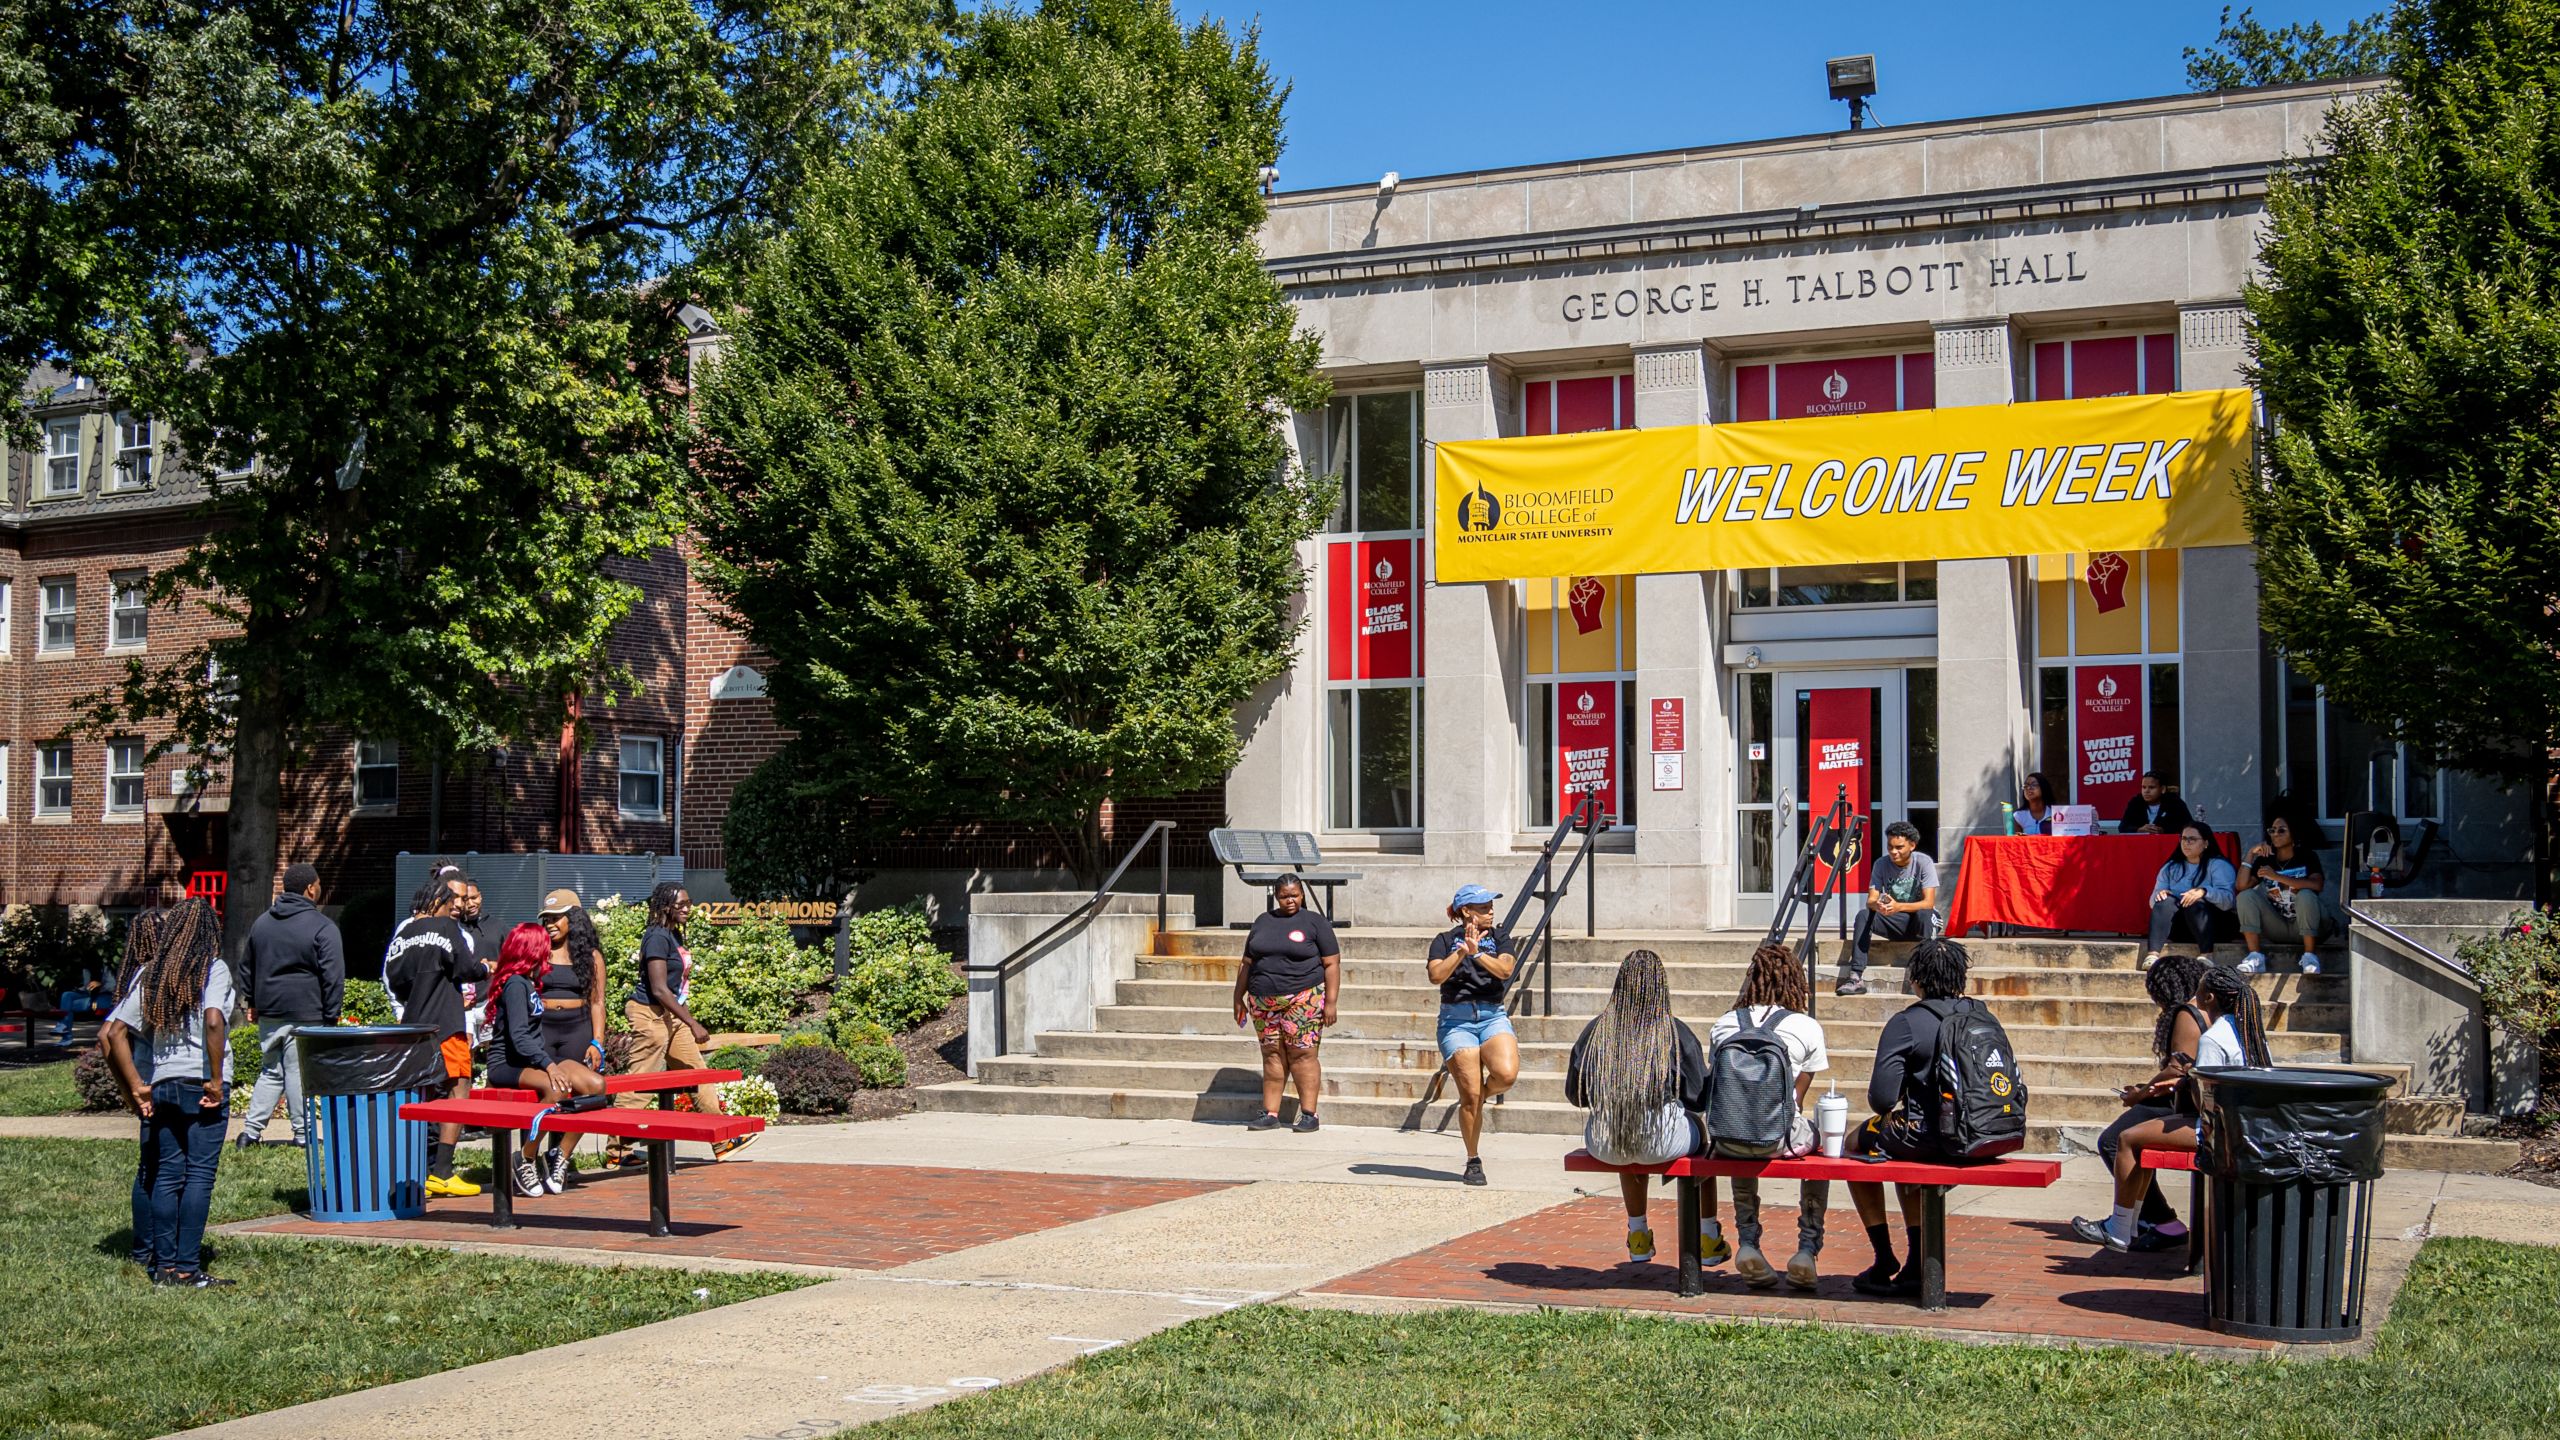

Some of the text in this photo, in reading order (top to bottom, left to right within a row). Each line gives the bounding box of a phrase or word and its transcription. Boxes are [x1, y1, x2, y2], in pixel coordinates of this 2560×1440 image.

[1562, 251, 2087, 324] GEORGE H. TALBOTT HALL
[1806, 401, 1866, 414] BLOOMFIELD
[1675, 438, 2191, 525] WELCOME WEEK
[1504, 488, 1614, 509] BLOOMFIELD
[1504, 507, 1598, 526] COLLEGE of
[1457, 527, 1614, 544] MONTCLAIR STATE UNIVERSITY
[1363, 581, 1405, 590] BLOOMFIELD
[1365, 603, 1404, 617] BLACK
[1369, 613, 1401, 625] LIVES
[1362, 621, 1408, 635] MATTER
[2085, 698, 2131, 706] BLOOMFIELD
[1822, 742, 1860, 754] BLACK
[2083, 735, 2135, 751] WRITE
[1564, 747, 1609, 762] WRITE
[1825, 751, 1857, 761] LIVES
[2087, 747, 2132, 762] YOUR
[1567, 758, 1607, 772] YOUR
[1818, 758, 1863, 770] MATTER
[2089, 759, 2129, 773] OWN
[1569, 769, 1604, 782] OWN
[2083, 770, 2136, 785] STORY
[2003, 1104, 2011, 1113] 15
